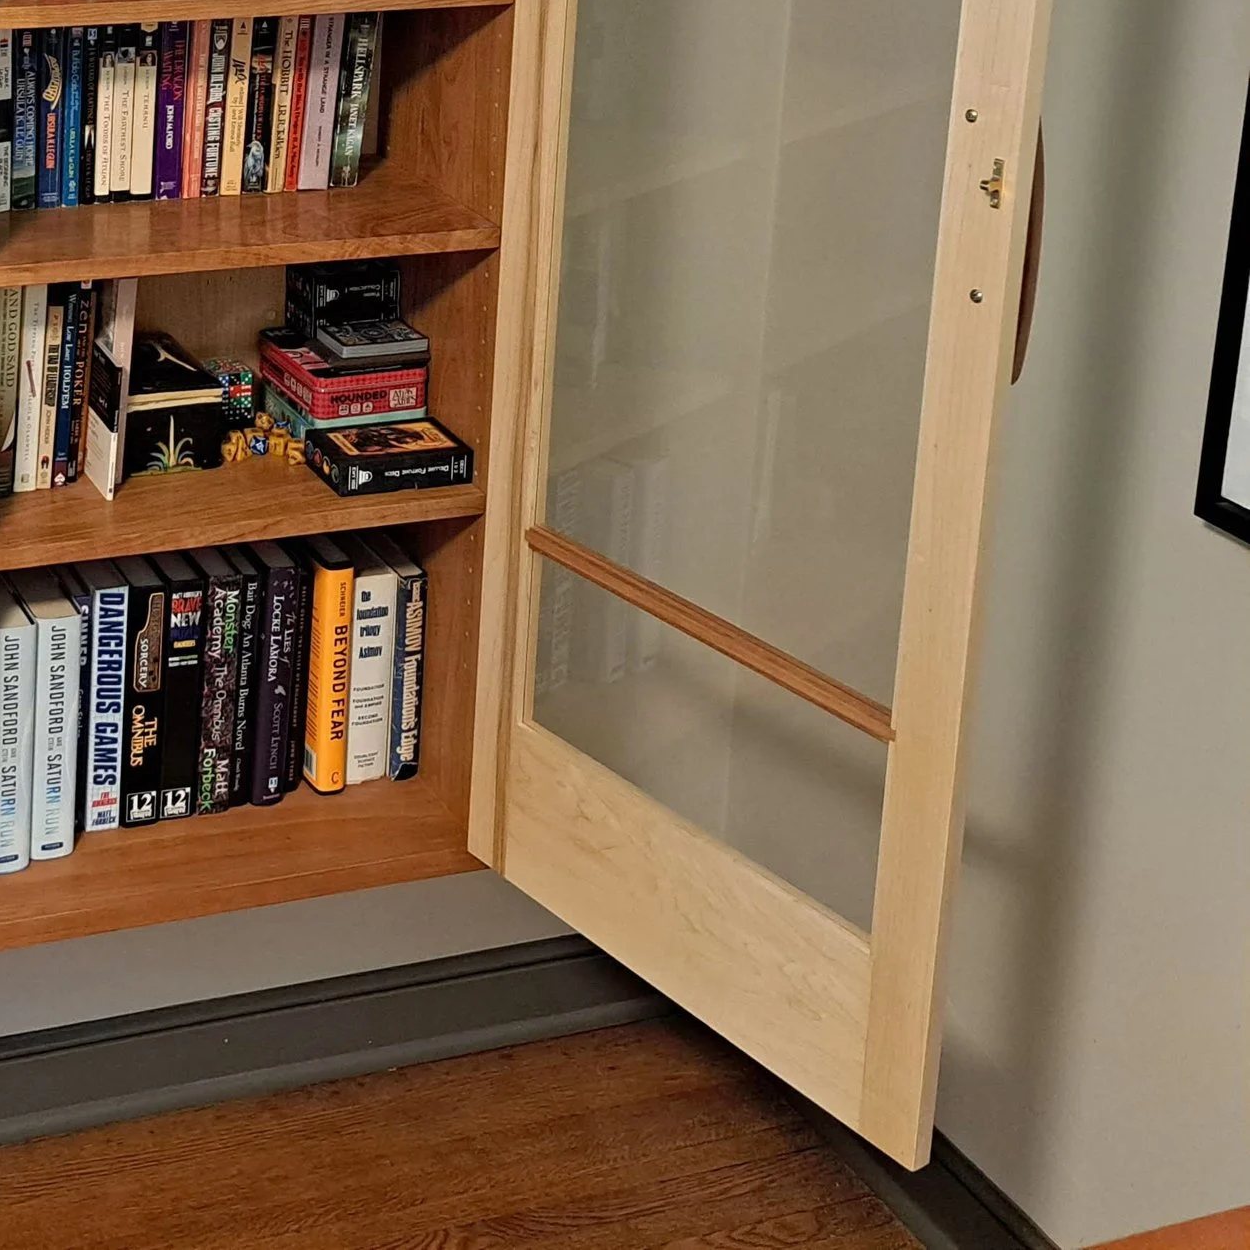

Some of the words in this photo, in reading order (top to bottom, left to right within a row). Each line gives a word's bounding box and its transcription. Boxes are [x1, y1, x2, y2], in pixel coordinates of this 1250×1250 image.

[284, 31, 293, 47] The
[279, 50, 292, 96] HOBBIT
[351, 38, 369, 99] HELLSPARK
[9, 290, 18, 318] AND
[78, 300, 90, 333] zen
[7, 323, 18, 352] GOD
[5, 355, 16, 387] SAID
[60, 365, 72, 409] HOLD'EM
[72, 361, 85, 406] POKER
[330, 390, 387, 404] HOUNDED
[170, 612, 200, 629] NEW
[172, 597, 202, 613] BRAVE
[209, 587, 226, 659] Academy
[223, 589, 240, 652] Monster
[271, 595, 283, 631] LOCKE
[2, 636, 21, 670] JOHN
[51, 626, 67, 660] JOHN
[96, 592, 126, 713] DANGEROUS
[137, 638, 148, 688] SORCERY
[267, 635, 282, 682] LAMORA
[332, 624, 348, 692] BEYOND
[215, 663, 227, 687] The
[1, 676, 20, 745] SANDFORD
[48, 665, 65, 734] SANDFORD
[211, 690, 226, 742] Omnibus
[330, 699, 345, 741] FEAR
[93, 722, 118, 786] GAMES
[130, 705, 145, 767] OMNIBUS
[143, 717, 158, 747] THE
[0, 766, 17, 816] SATURN
[45, 755, 62, 804] SATURN
[200, 748, 217, 810] Forbeck
[215, 759, 228, 794] Matt
[0, 821, 15, 848] RUN
[44, 810, 60, 835] RUN
